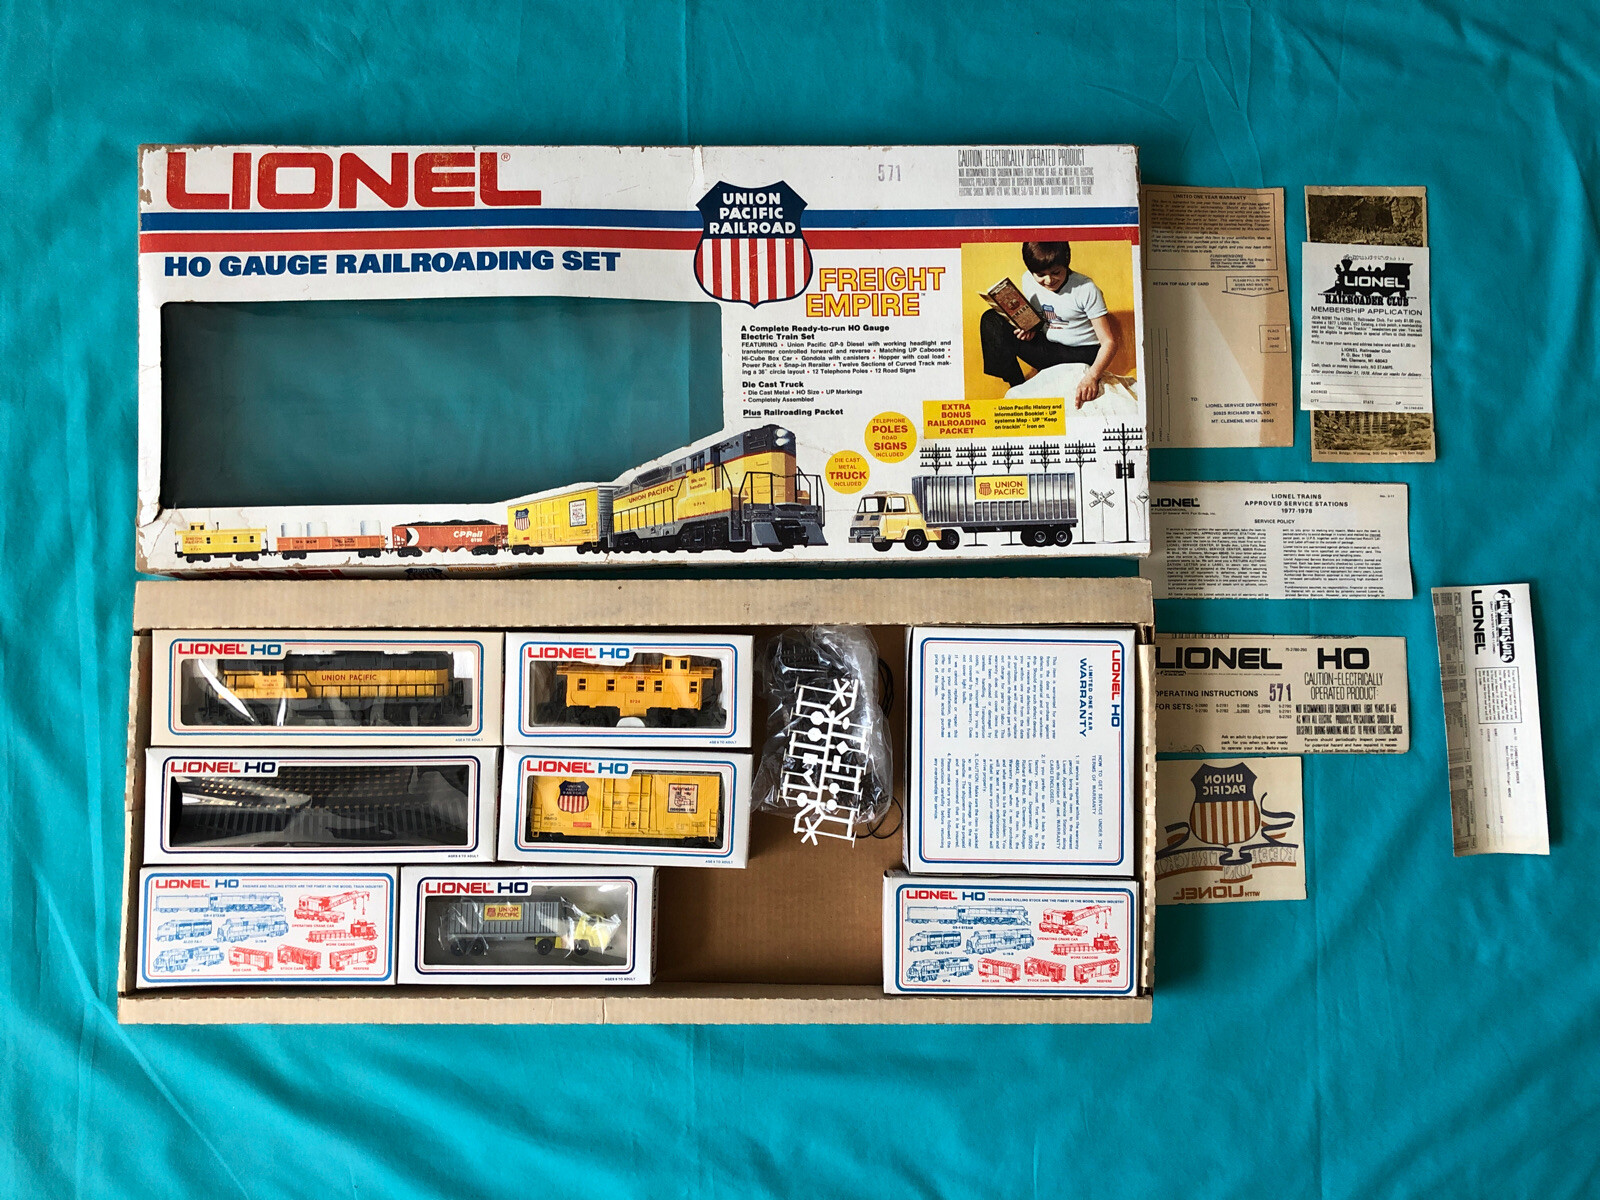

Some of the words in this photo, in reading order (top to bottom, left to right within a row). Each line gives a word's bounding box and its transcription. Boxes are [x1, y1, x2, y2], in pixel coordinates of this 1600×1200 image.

[1026, 149, 1055, 166] OPERATED
[1058, 149, 1084, 166] PRODUCT
[878, 164, 901, 182] 571
[167, 152, 541, 210] LIONEL
[722, 192, 781, 205] UNION
[719, 207, 783, 220] PACIFIC
[709, 221, 796, 234] RAILROAD
[164, 257, 213, 277] HO
[219, 254, 327, 276] GAUGE
[336, 250, 554, 275] RAILROADING
[562, 251, 620, 272] SET
[819, 267, 946, 291] FREIGHT
[1344, 276, 1405, 288] LIONEL
[806, 293, 920, 317] EMPIRE
[1325, 294, 1384, 306] RAILROADER
[1387, 296, 1409, 306] CLUB
[927, 418, 986, 427] RAILROADING
[872, 425, 908, 434] POLES
[873, 442, 908, 451] SIGNS
[829, 471, 867, 480] TRUCK
[994, 487, 1025, 496] PACIFIC
[995, 481, 1023, 489] UNION
[629, 494, 646, 503] UNION
[648, 485, 674, 497] PACIFIC
[1471, 590, 1486, 655] LIONEL
[178, 644, 247, 655] LIONEL
[250, 644, 282, 655] HO
[528, 647, 596, 658] LIONEL
[600, 648, 629, 659] HO
[1156, 647, 1282, 669] LIONEL
[1317, 648, 1370, 670] HO
[1112, 650, 1120, 700] LIONEL
[1304, 672, 1383, 686] CAUTION-ELECTRICALLY
[1079, 658, 1088, 738] WARRANTY
[1269, 683, 1291, 702] 571
[1311, 687, 1344, 700] OPERATED
[1112, 704, 1120, 727] HO
[170, 761, 241, 774] LIONEL
[244, 762, 276, 773] HO
[527, 760, 595, 773] LIONEL
[598, 762, 628, 775] HO
[156, 879, 210, 889] LIONEL
[215, 879, 239, 888] HO
[425, 882, 494, 894] LIONEL
[497, 882, 528, 893] HO
[906, 890, 958, 900] LIONEL
[962, 891, 985, 901] HO
